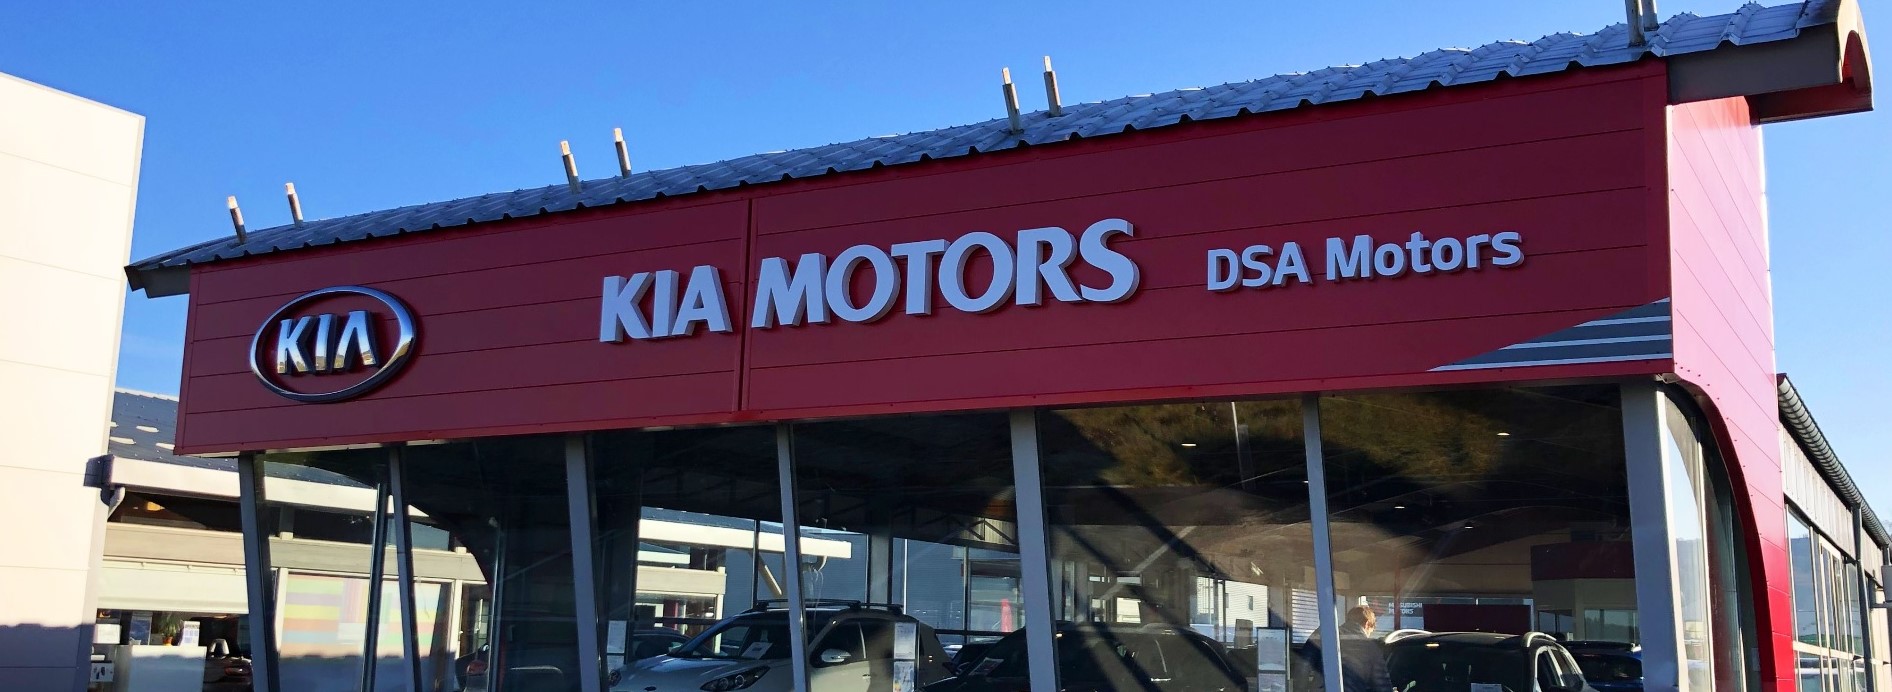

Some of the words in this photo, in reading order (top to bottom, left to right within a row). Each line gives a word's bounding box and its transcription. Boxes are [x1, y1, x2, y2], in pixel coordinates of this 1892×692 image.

[600, 265, 733, 343] KIA
[751, 218, 1140, 329] MOTORS
[1207, 242, 1311, 292] DSA
[1326, 231, 1523, 281] Motors
[276, 311, 379, 374] KIA
